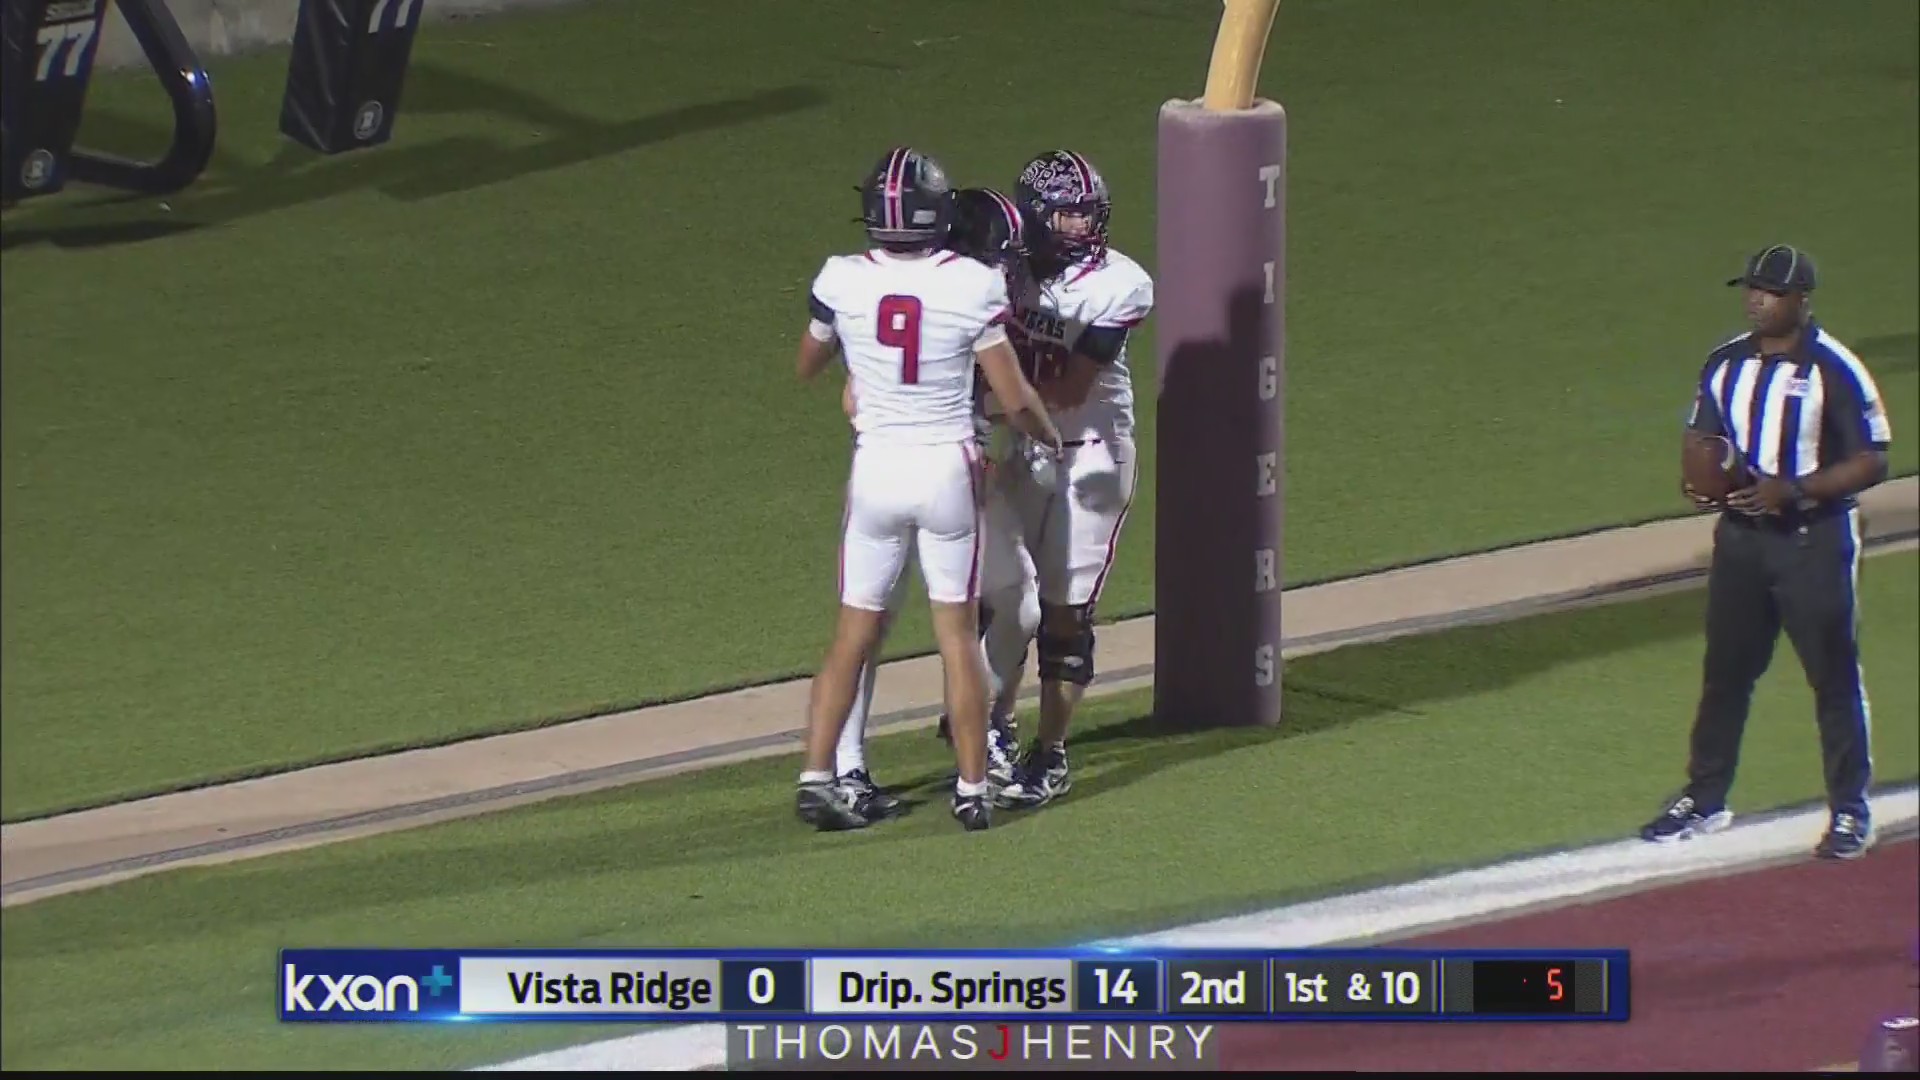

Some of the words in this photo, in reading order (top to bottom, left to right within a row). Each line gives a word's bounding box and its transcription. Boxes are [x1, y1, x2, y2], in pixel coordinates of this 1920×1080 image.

[35, 20, 96, 81] 77
[877, 294, 922, 385] 9
[1255, 165, 1281, 688] TIGERS
